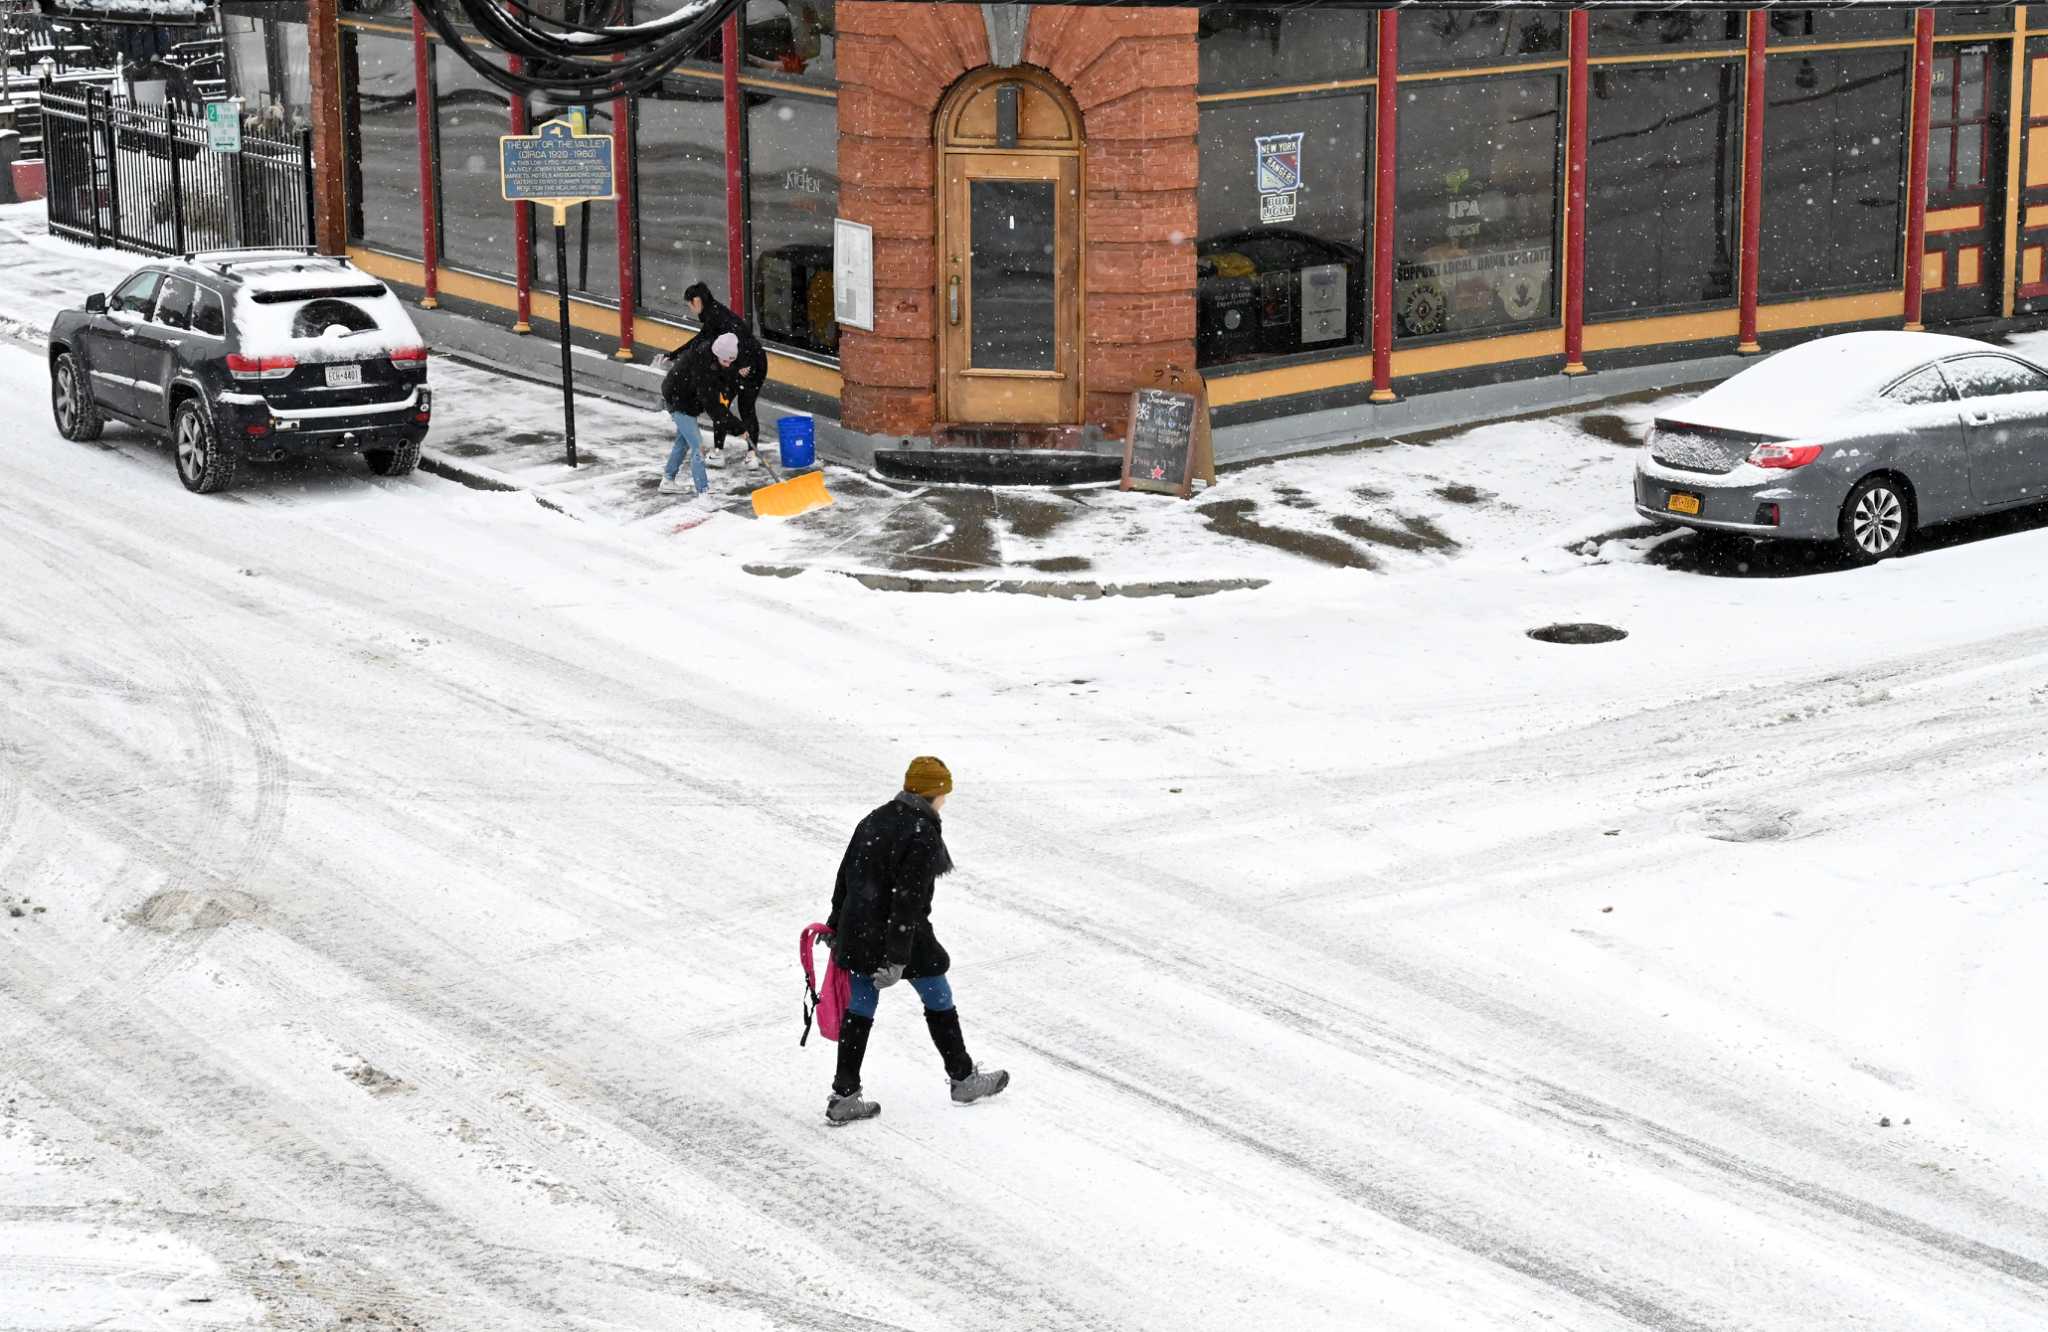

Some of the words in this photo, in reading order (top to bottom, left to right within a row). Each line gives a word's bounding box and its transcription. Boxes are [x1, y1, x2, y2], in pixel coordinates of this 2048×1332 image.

[1261, 143, 1277, 154] NEW
[1279, 141, 1297, 152] YORK
[1266, 156, 1297, 185] RANGERS
[1266, 195, 1290, 207] BUD
[1448, 200, 1481, 218] IPA
[1263, 204, 1294, 218] LIGHT
[1397, 264, 1440, 282] SUPPORT
